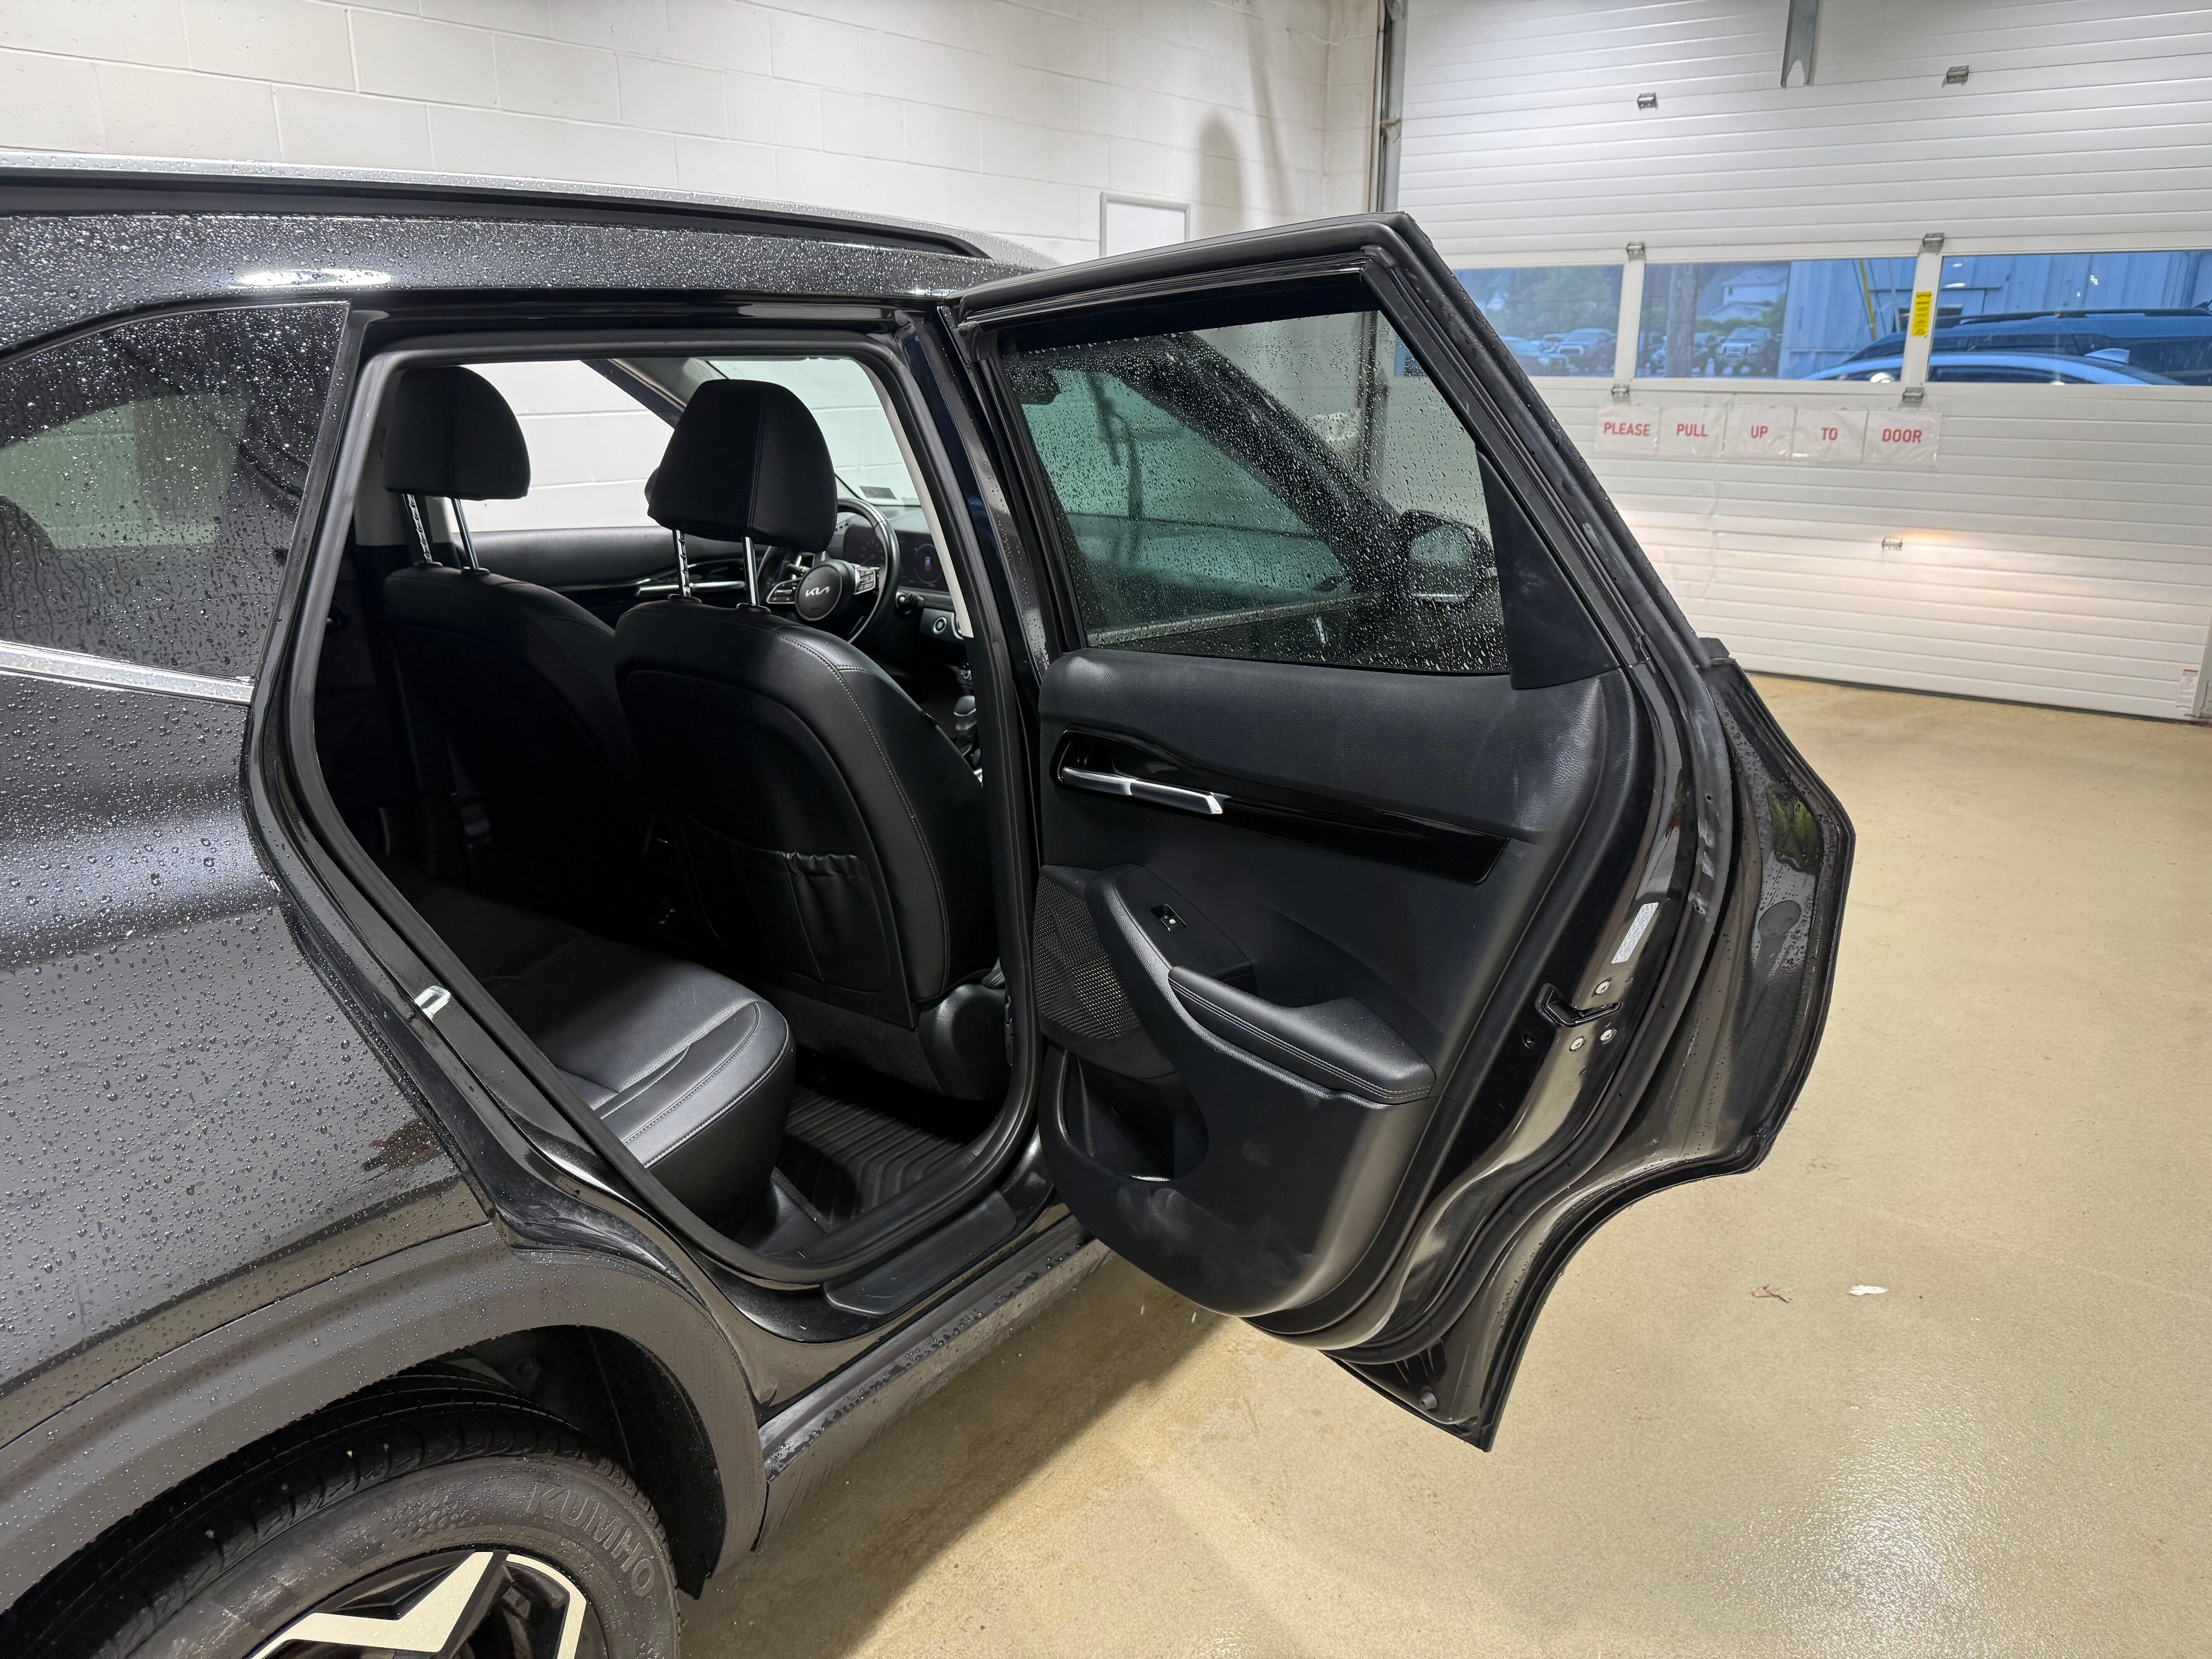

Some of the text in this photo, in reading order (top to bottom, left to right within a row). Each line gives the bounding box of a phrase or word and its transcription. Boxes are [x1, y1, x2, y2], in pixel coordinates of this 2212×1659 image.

[1604, 422, 1923, 444] PLEASE PULL UP TO DOOR
[805, 586, 830, 597] KIA
[526, 1480, 655, 1597] KUMHO
